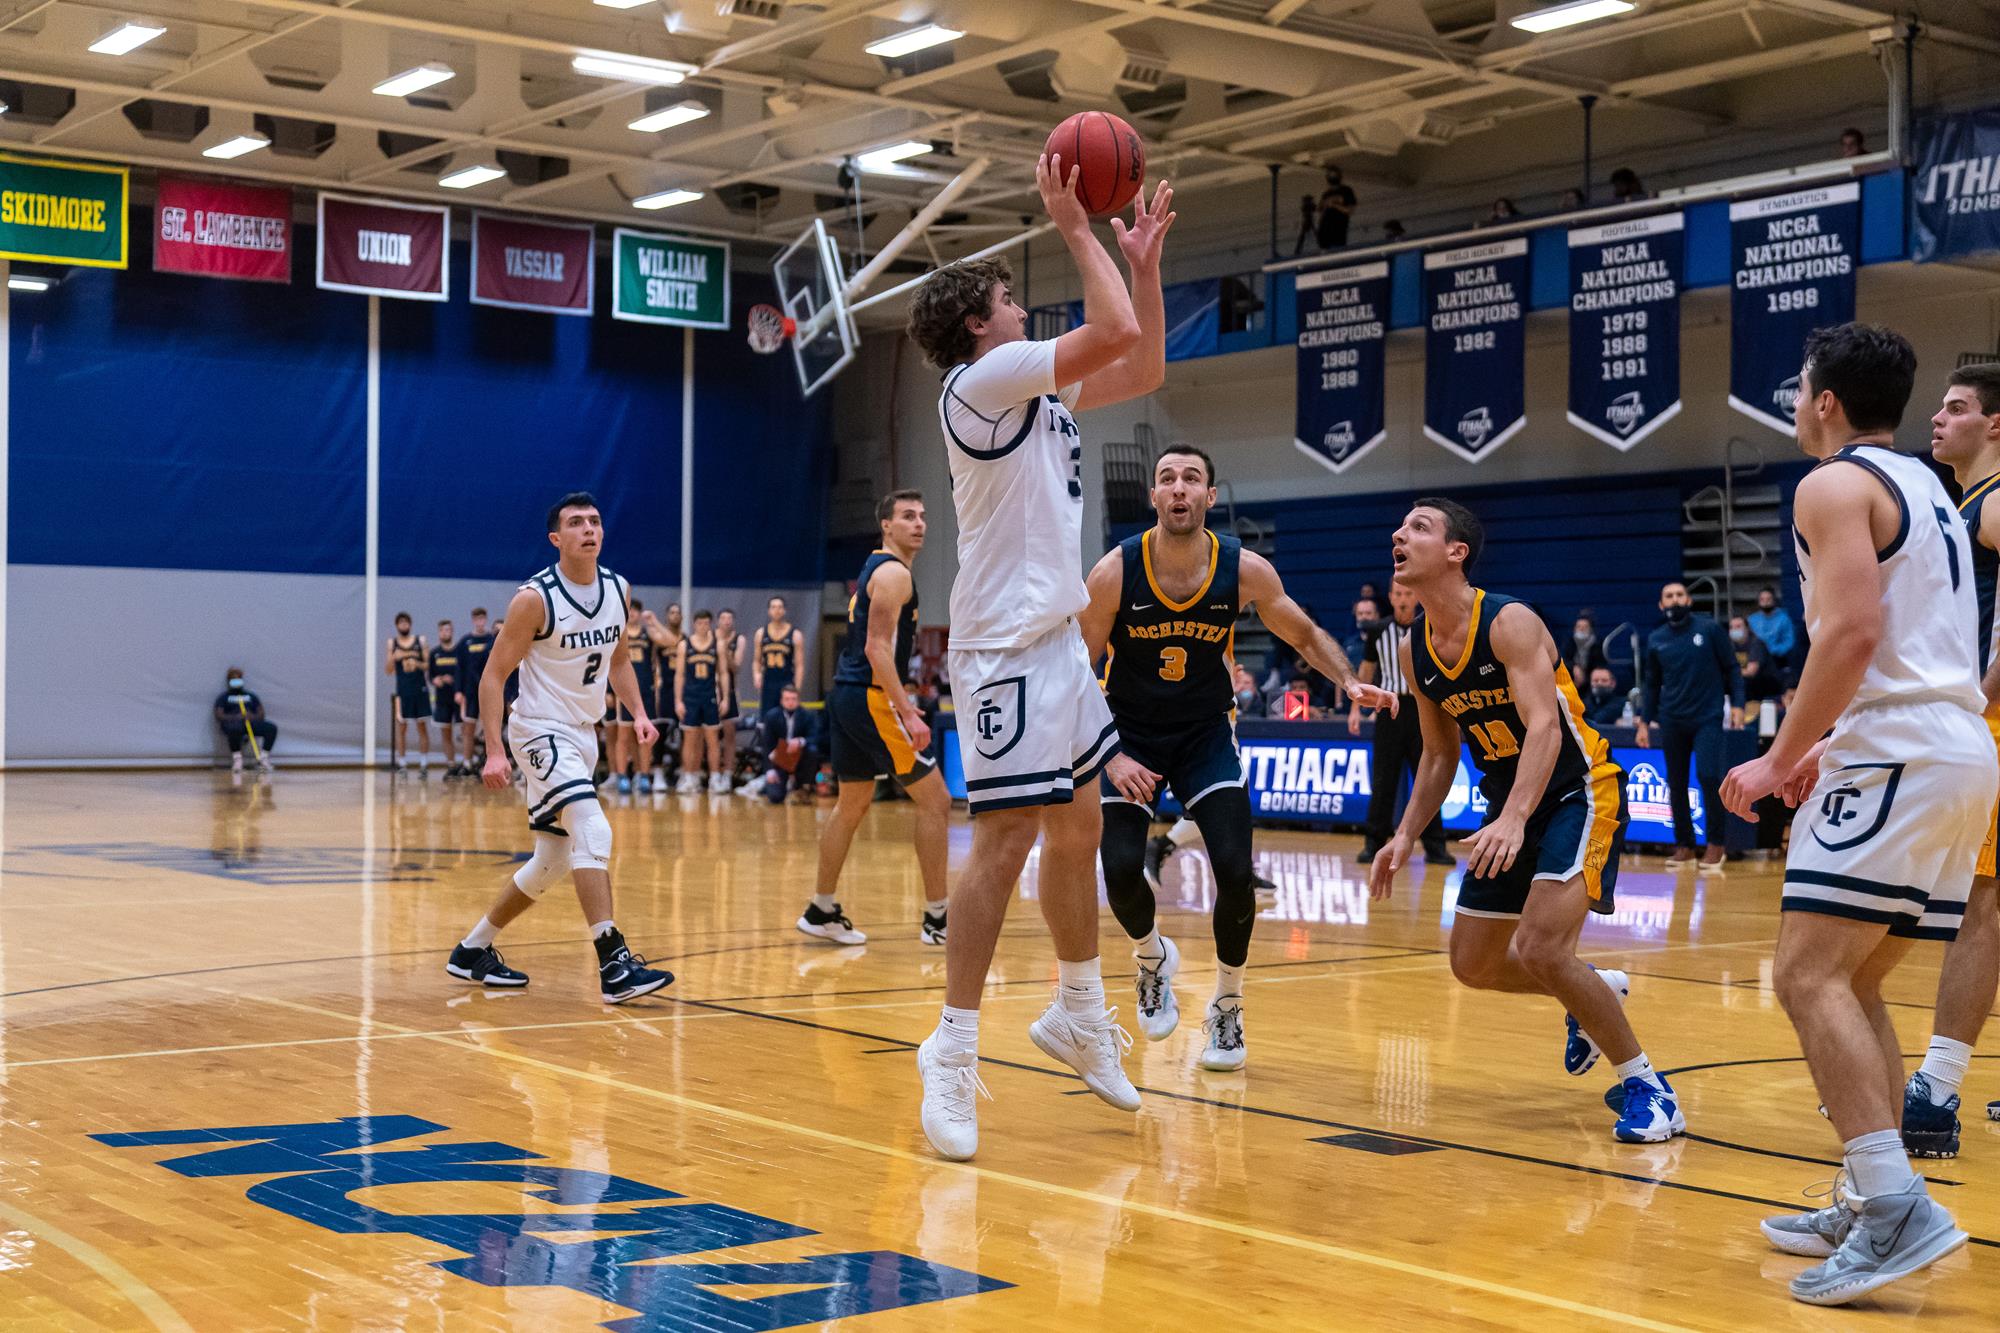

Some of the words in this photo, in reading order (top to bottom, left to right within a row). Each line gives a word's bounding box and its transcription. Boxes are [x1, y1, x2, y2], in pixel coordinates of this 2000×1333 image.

[1, 191, 106, 232] SKIDMORE
[162, 207, 191, 243] ST.
[194, 210, 285, 251] LAWRENCE
[1767, 214, 1820, 240] NCGA
[358, 230, 412, 266] UNION
[1601, 242, 1650, 267] NCAA
[1744, 233, 1843, 266] NATIONAL
[505, 246, 564, 282] VASSAR
[638, 247, 708, 283] WILLIAM
[1454, 265, 1497, 288] NCAA
[1581, 260, 1669, 289] NATIONAL
[1736, 255, 1851, 289] CHAMPIONS
[646, 282, 698, 311] SMITH
[1322, 287, 1360, 307] NCAA
[1437, 283, 1515, 310] NATIONAL
[1573, 280, 1675, 311] CHAMPIONS
[1767, 287, 1819, 313] 1998
[1306, 304, 1375, 329] NATIONAL
[1432, 302, 1520, 331] CHAMPIONS
[1602, 311, 1648, 334] 1979
[1299, 322, 1383, 348] CHAMPIONS
[1454, 331, 1496, 353] 1982
[1602, 334, 1648, 357] 1988
[1321, 349, 1359, 369] 1980
[1602, 357, 1648, 381] 1991
[560, 625, 621, 649] ITHACA
[583, 652, 602, 687] 2
[1158, 646, 1188, 682] 3
[1240, 746, 1372, 796] ITHACA
[1259, 791, 1344, 815] BOMBERS
[87, 1115, 1019, 1333] NCAA
